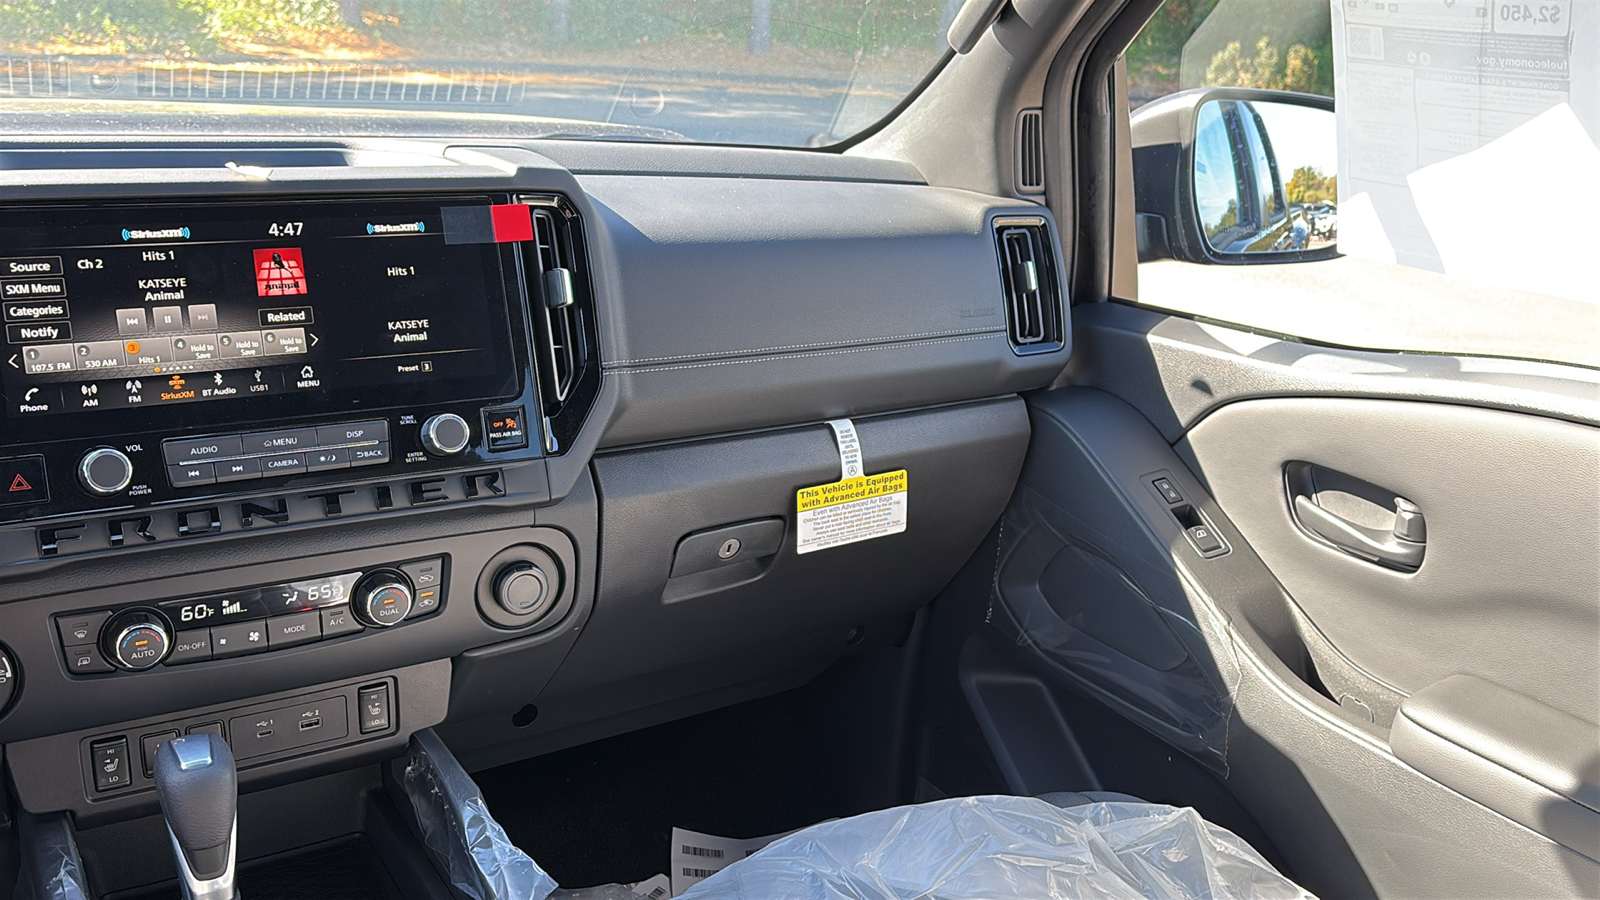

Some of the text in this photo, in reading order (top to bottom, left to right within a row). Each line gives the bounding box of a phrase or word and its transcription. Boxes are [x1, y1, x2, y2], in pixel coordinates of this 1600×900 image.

[268, 222, 303, 237] 4:47
[143, 251, 175, 262] Hits 1
[10, 262, 50, 272] Source
[77, 259, 103, 269] Ch 2
[387, 267, 415, 276] Hits 1
[6, 282, 61, 294] SXM Menu
[138, 278, 187, 289] KATSEYE
[145, 290, 185, 301] Animal
[10, 304, 63, 317] Categories
[267, 311, 305, 322] Related
[388, 319, 429, 330] KATSEYE
[21, 327, 58, 339] Notify
[394, 332, 427, 343] Animal
[280, 338, 294, 346] Hold
[190, 344, 206, 352] Hold
[240, 348, 256, 356] Save
[284, 344, 299, 353] Save
[139, 356, 154, 364] Hits
[195, 351, 211, 359] Save
[31, 362, 70, 372] 107.5 FM
[85, 359, 102, 368] 530
[297, 380, 320, 388] MENU
[161, 390, 194, 400] SiriusXM
[202, 386, 236, 396] BT Audio
[83, 399, 98, 407] AM
[128, 395, 142, 403] FM
[20, 403, 48, 413] Phone
[273, 437, 298, 446] MENU
[126, 444, 143, 453] VOL
[190, 445, 218, 455] AUDIO
[364, 449, 383, 458] BACK
[268, 458, 298, 469] CAMERA
[800, 472, 903, 499] This Vehicle is Equipped
[801, 481, 902, 508] with Advanced Air Bags
[813, 508, 827, 516] Even
[841, 500, 868, 510] Advanced
[878, 495, 892, 503] Bags
[39, 468, 504, 556] FRONTIER
[379, 608, 400, 617] DUAL
[329, 617, 345, 626] A/C
[284, 624, 306, 634] MODE
[178, 641, 206, 652] ON-OFF
[131, 650, 155, 659] AUTO
